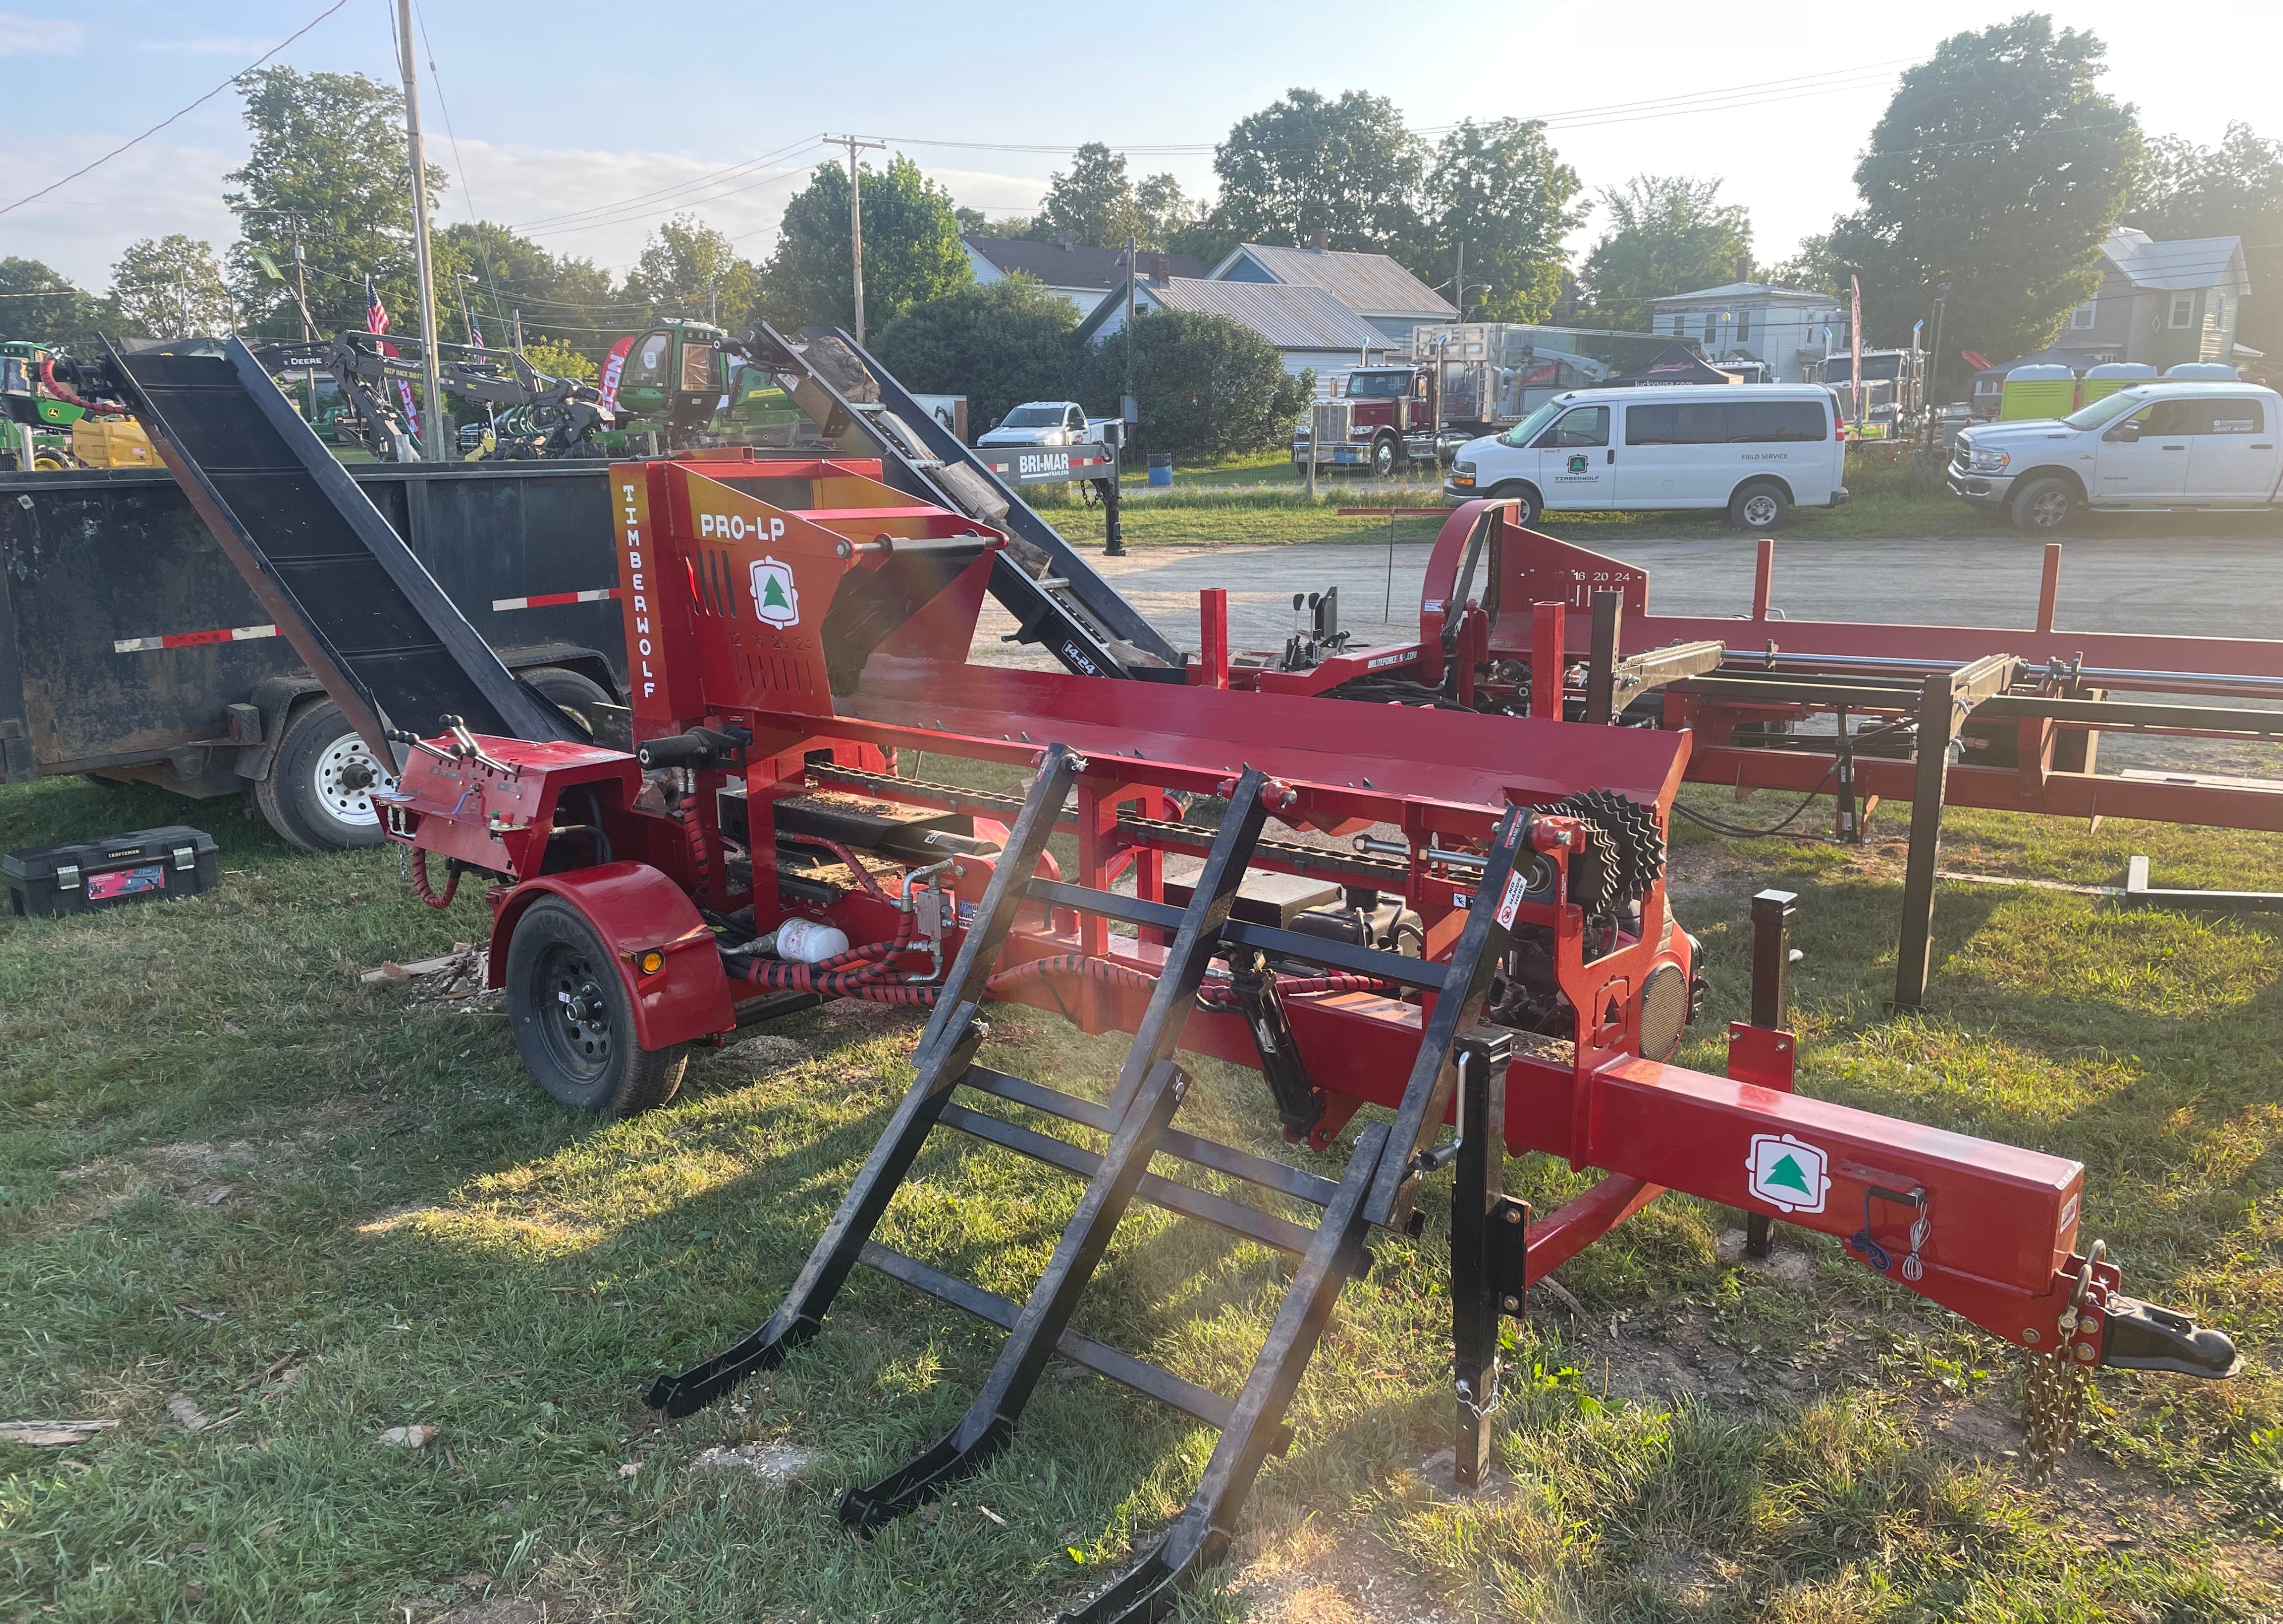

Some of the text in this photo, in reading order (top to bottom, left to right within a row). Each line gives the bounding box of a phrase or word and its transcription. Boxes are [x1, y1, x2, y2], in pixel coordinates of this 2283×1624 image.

[396, 369, 408, 377] BACK
[603, 354, 624, 431] ECON
[1019, 453, 1069, 473] BRI-MAR
[700, 514, 784, 542] PRO-LP
[1573, 571, 1586, 581] 16
[1594, 572, 1609, 581] 20
[1615, 573, 1630, 581] 24
[623, 485, 655, 698] TIMBERWOLF
[728, 632, 812, 651] 12 16 20 24
[1064, 643, 1096, 675] 14-24
[1509, 814, 1524, 845] GREASE POINT
[108, 849, 140, 858] CRAFTSMAN
[1508, 882, 1515, 894] NO
[1509, 877, 1521, 905] HANDS
[1514, 883, 1524, 905] HERE
[960, 901, 978, 911] Proudl
